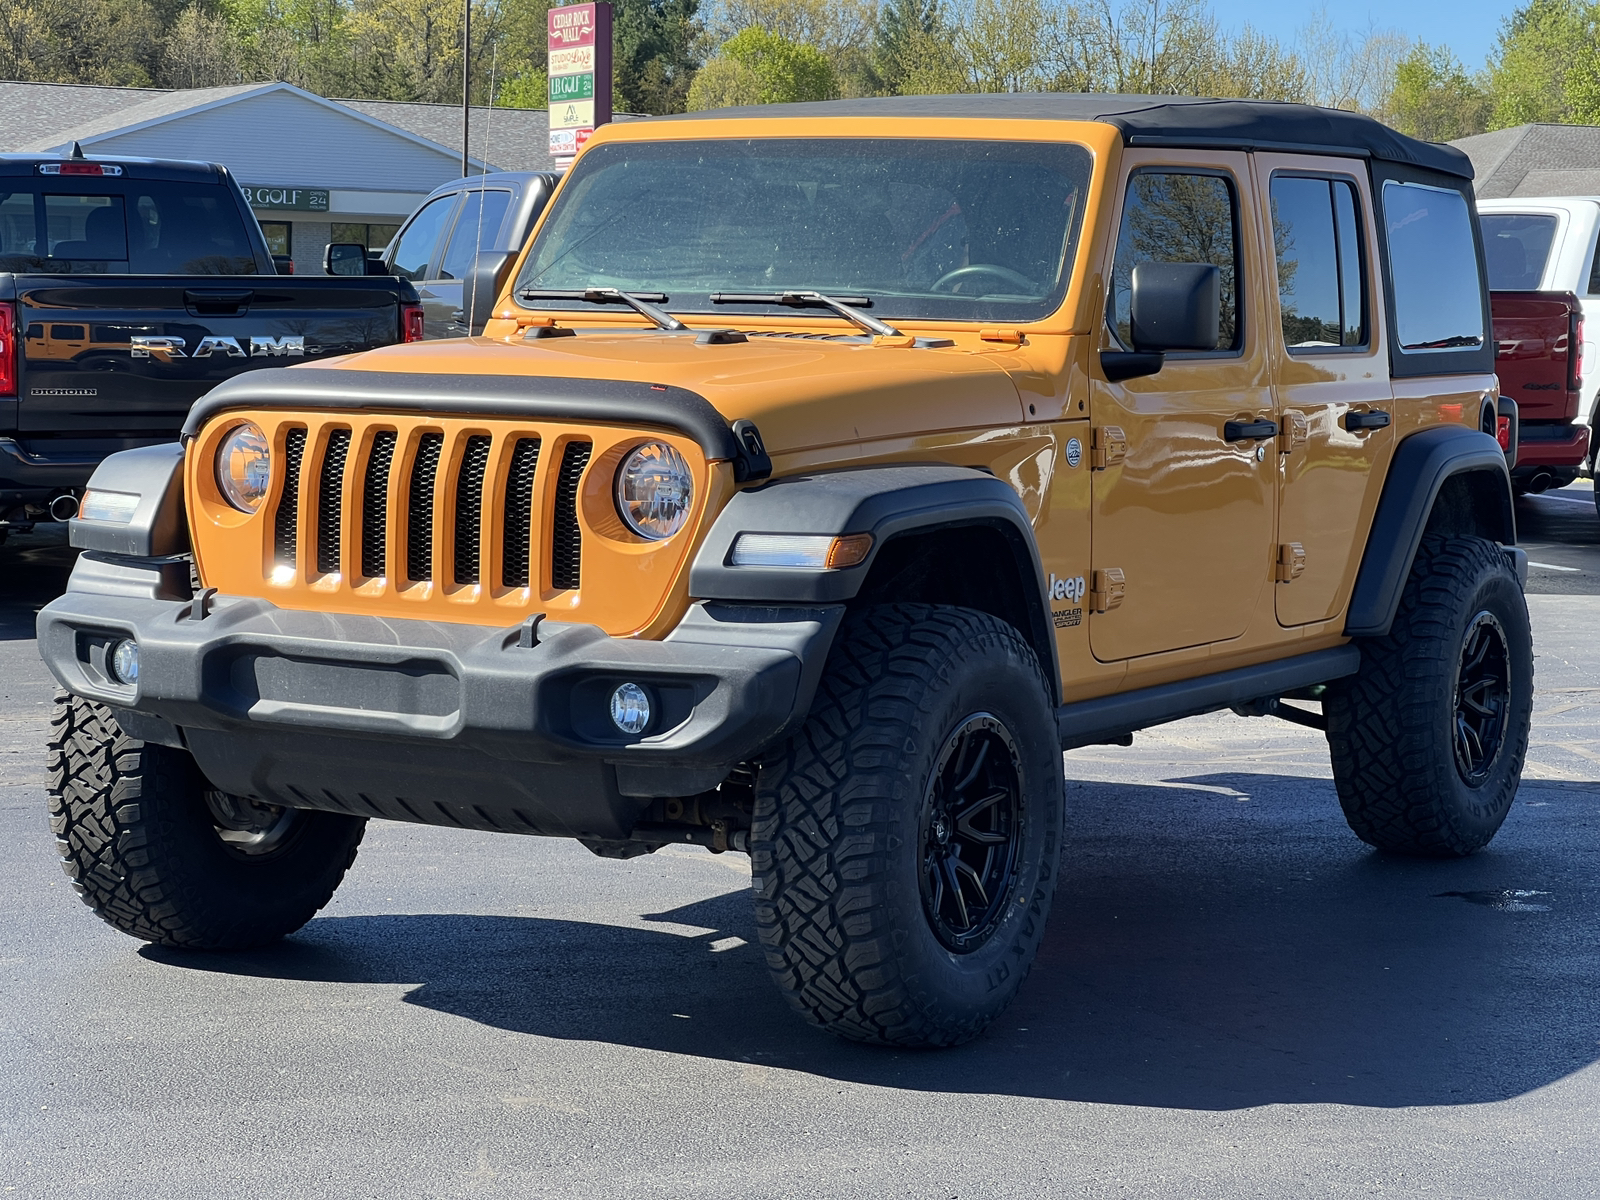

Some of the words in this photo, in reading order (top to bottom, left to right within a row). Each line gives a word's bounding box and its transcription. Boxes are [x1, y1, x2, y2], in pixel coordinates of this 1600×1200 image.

[553, 13, 573, 29] CEDAR
[573, 10, 590, 26] ROCK
[562, 26, 581, 43] MALL
[551, 53, 571, 65] STUDIO
[551, 77, 561, 95] LB
[561, 75, 581, 94] GOLF
[256, 188, 303, 205] GOLF
[309, 196, 327, 205] 24
[130, 335, 305, 358] RAM
[31, 387, 97, 396] BIGHORN
[1048, 573, 1085, 604] Jeep
[987, 960, 1010, 993] RT
